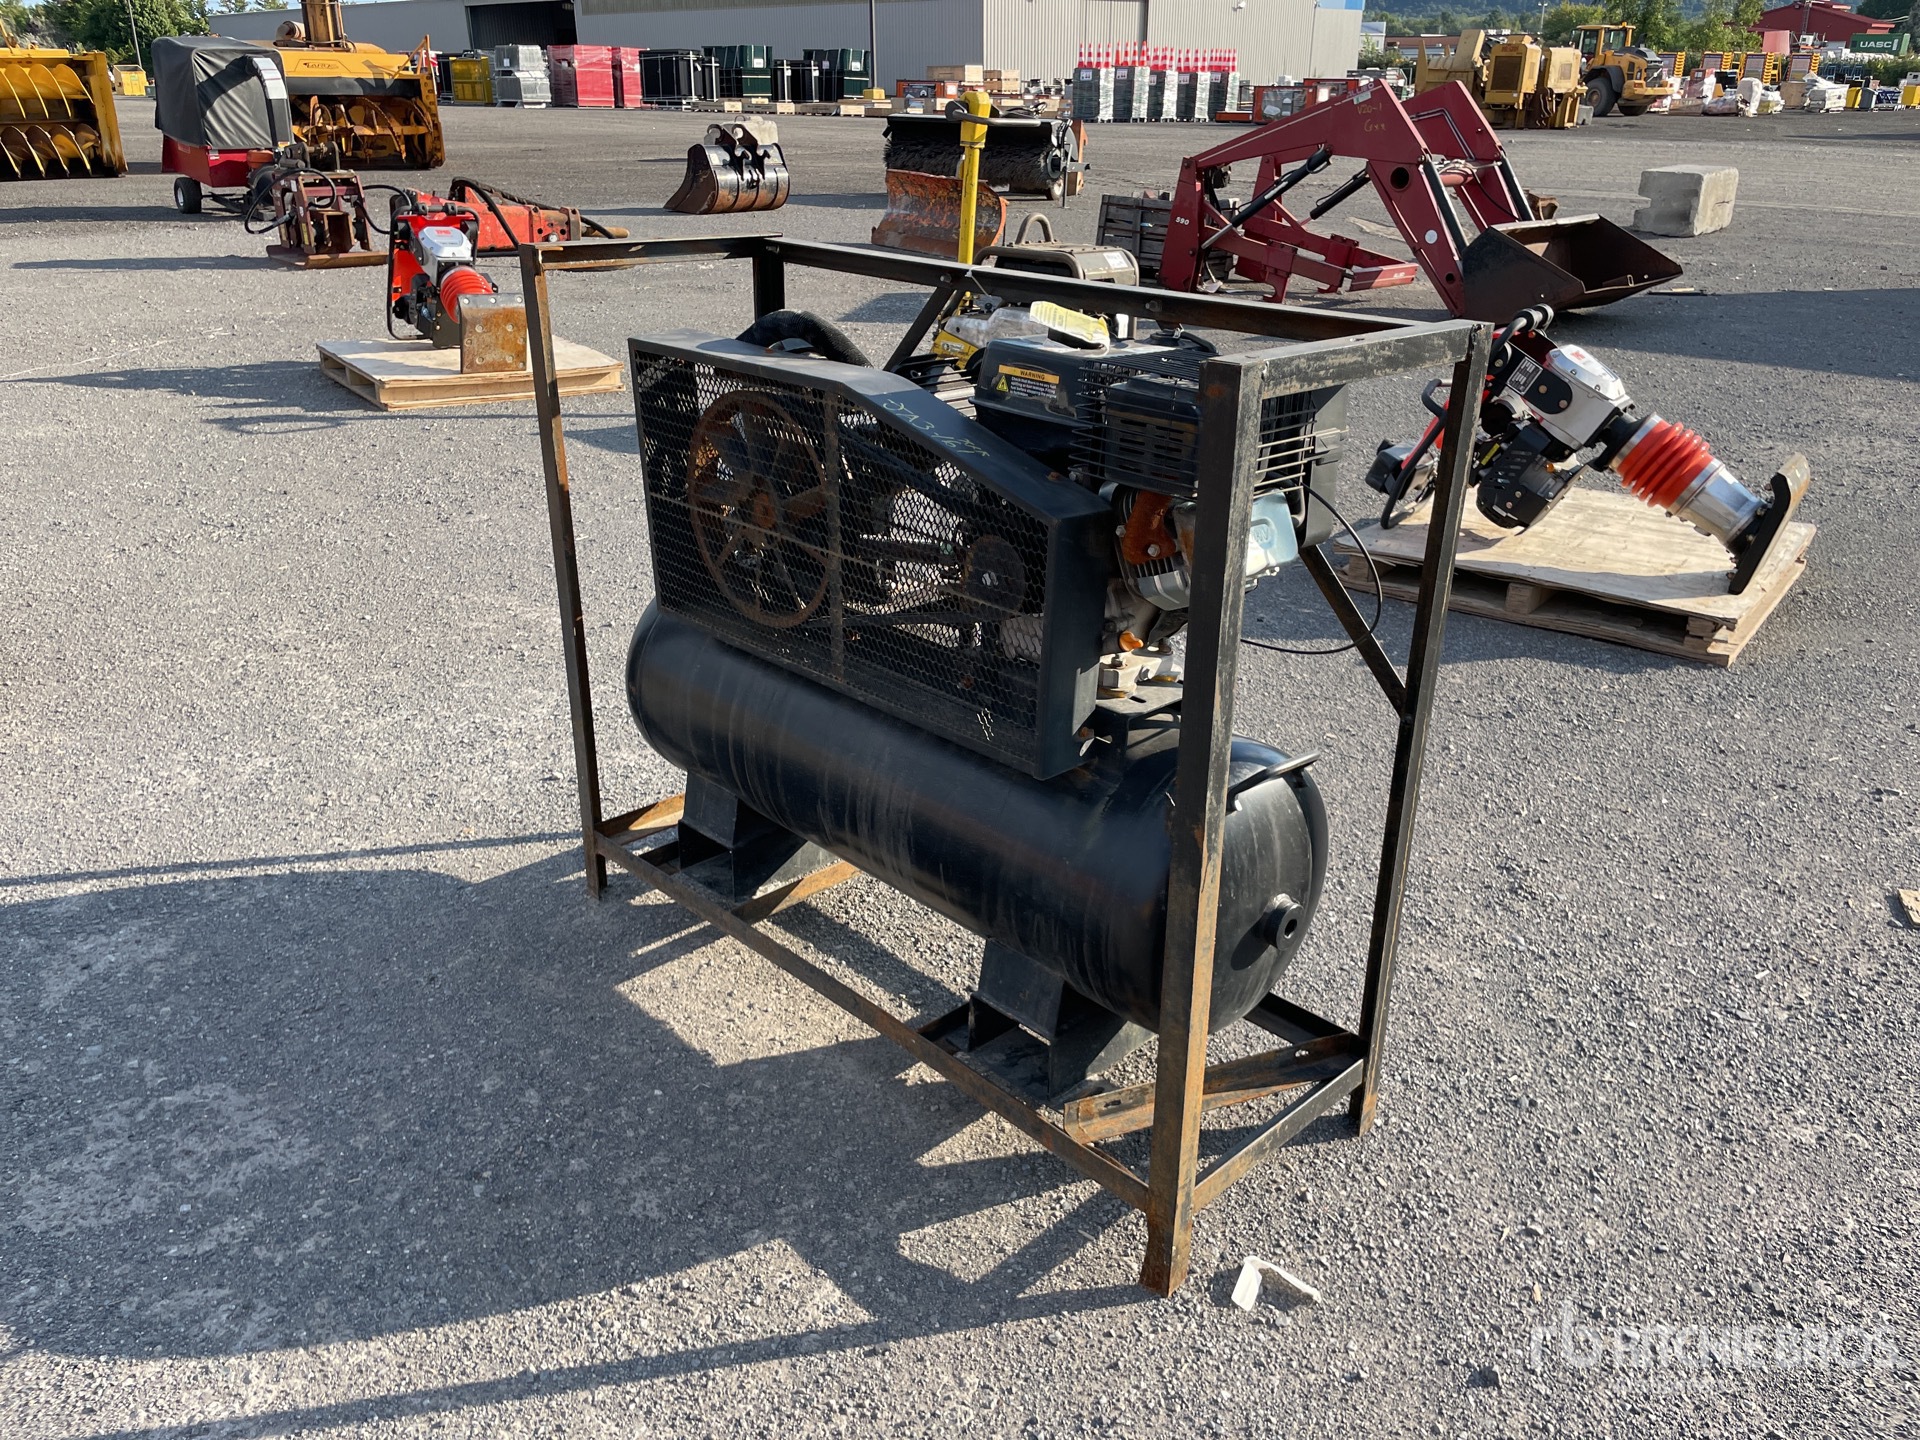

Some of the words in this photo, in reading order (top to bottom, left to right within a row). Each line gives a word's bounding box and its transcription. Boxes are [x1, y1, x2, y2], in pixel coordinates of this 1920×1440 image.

[1859, 40, 1892, 48] UASC
[1175, 216, 1190, 226] 590
[1020, 370, 1045, 380] WARNING
